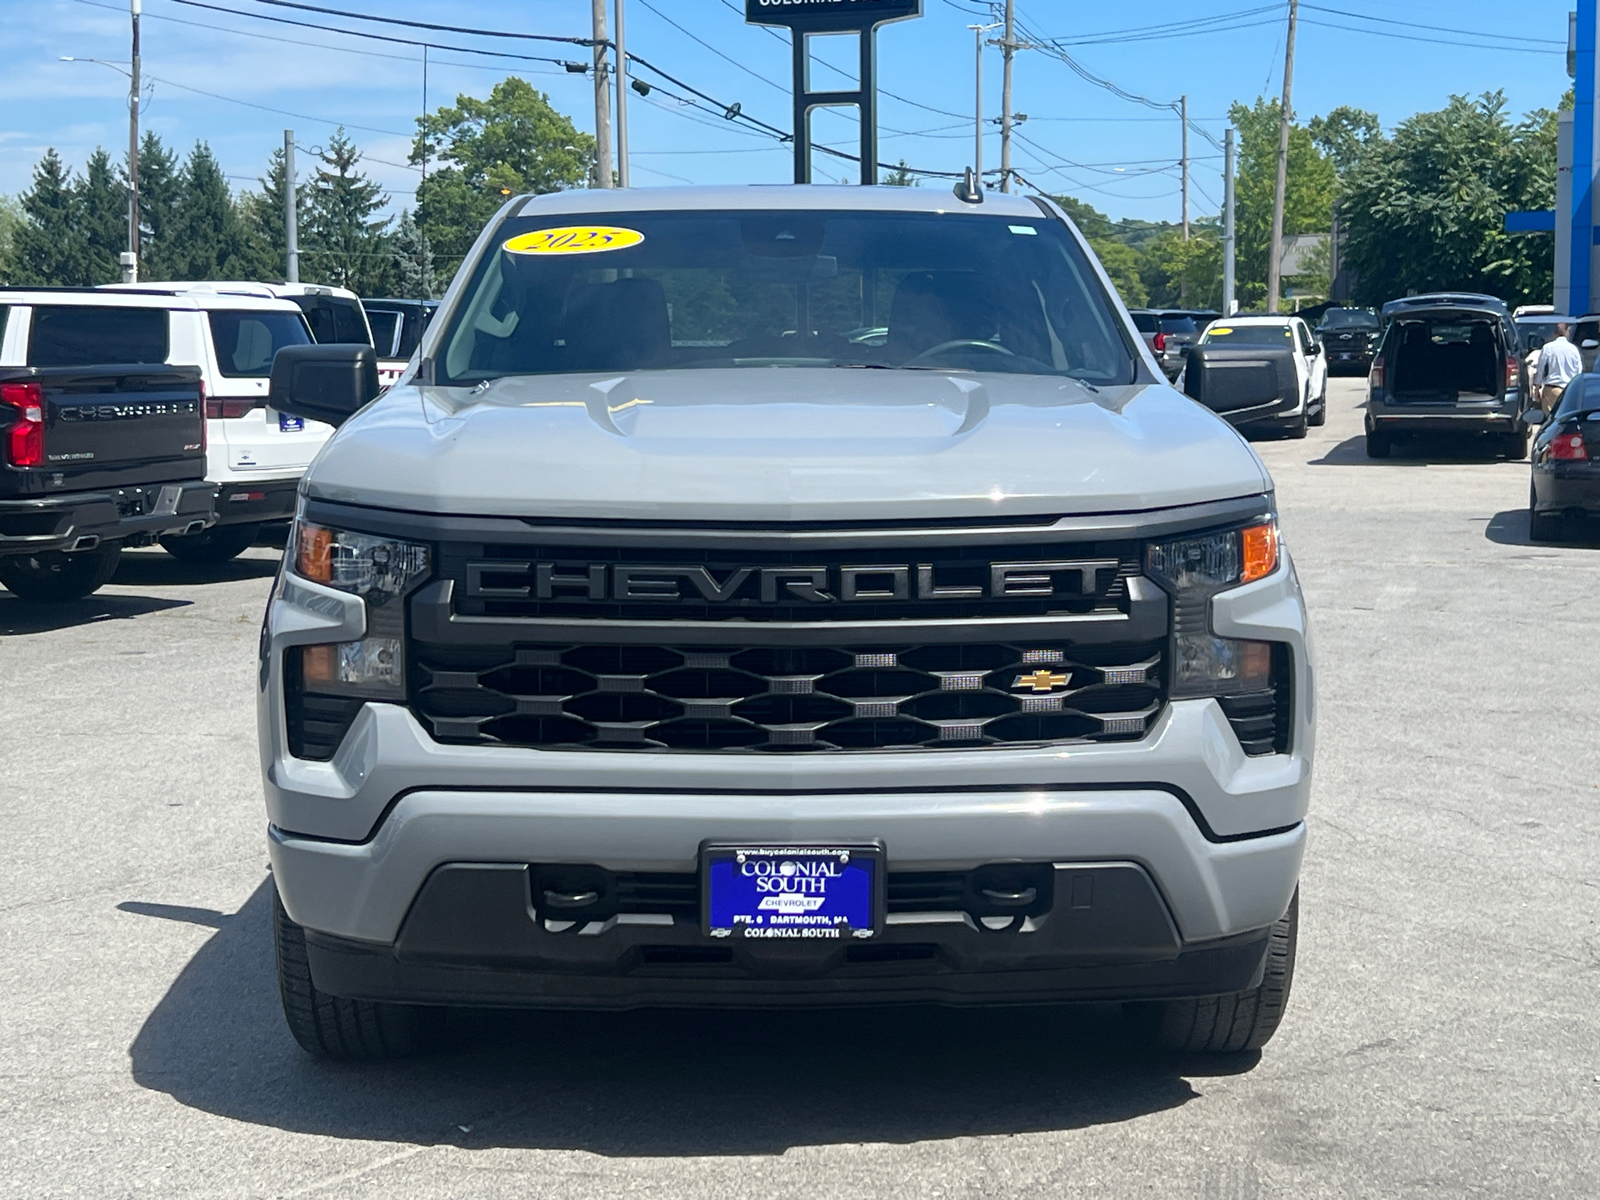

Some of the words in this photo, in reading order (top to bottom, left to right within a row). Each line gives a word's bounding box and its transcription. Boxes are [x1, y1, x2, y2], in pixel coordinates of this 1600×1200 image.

[524, 232, 623, 250] 2025
[61, 403, 196, 421] CHEVR
[466, 558, 1119, 601] CHEVROLET
[736, 849, 850, 857] www.buycolonialsouth.com
[741, 861, 842, 877] COLONIAL
[756, 877, 826, 893] SOUTH
[765, 899, 818, 907] CHEVROLET
[744, 928, 800, 938] COLONIAL
[802, 928, 840, 938] SOUTH
